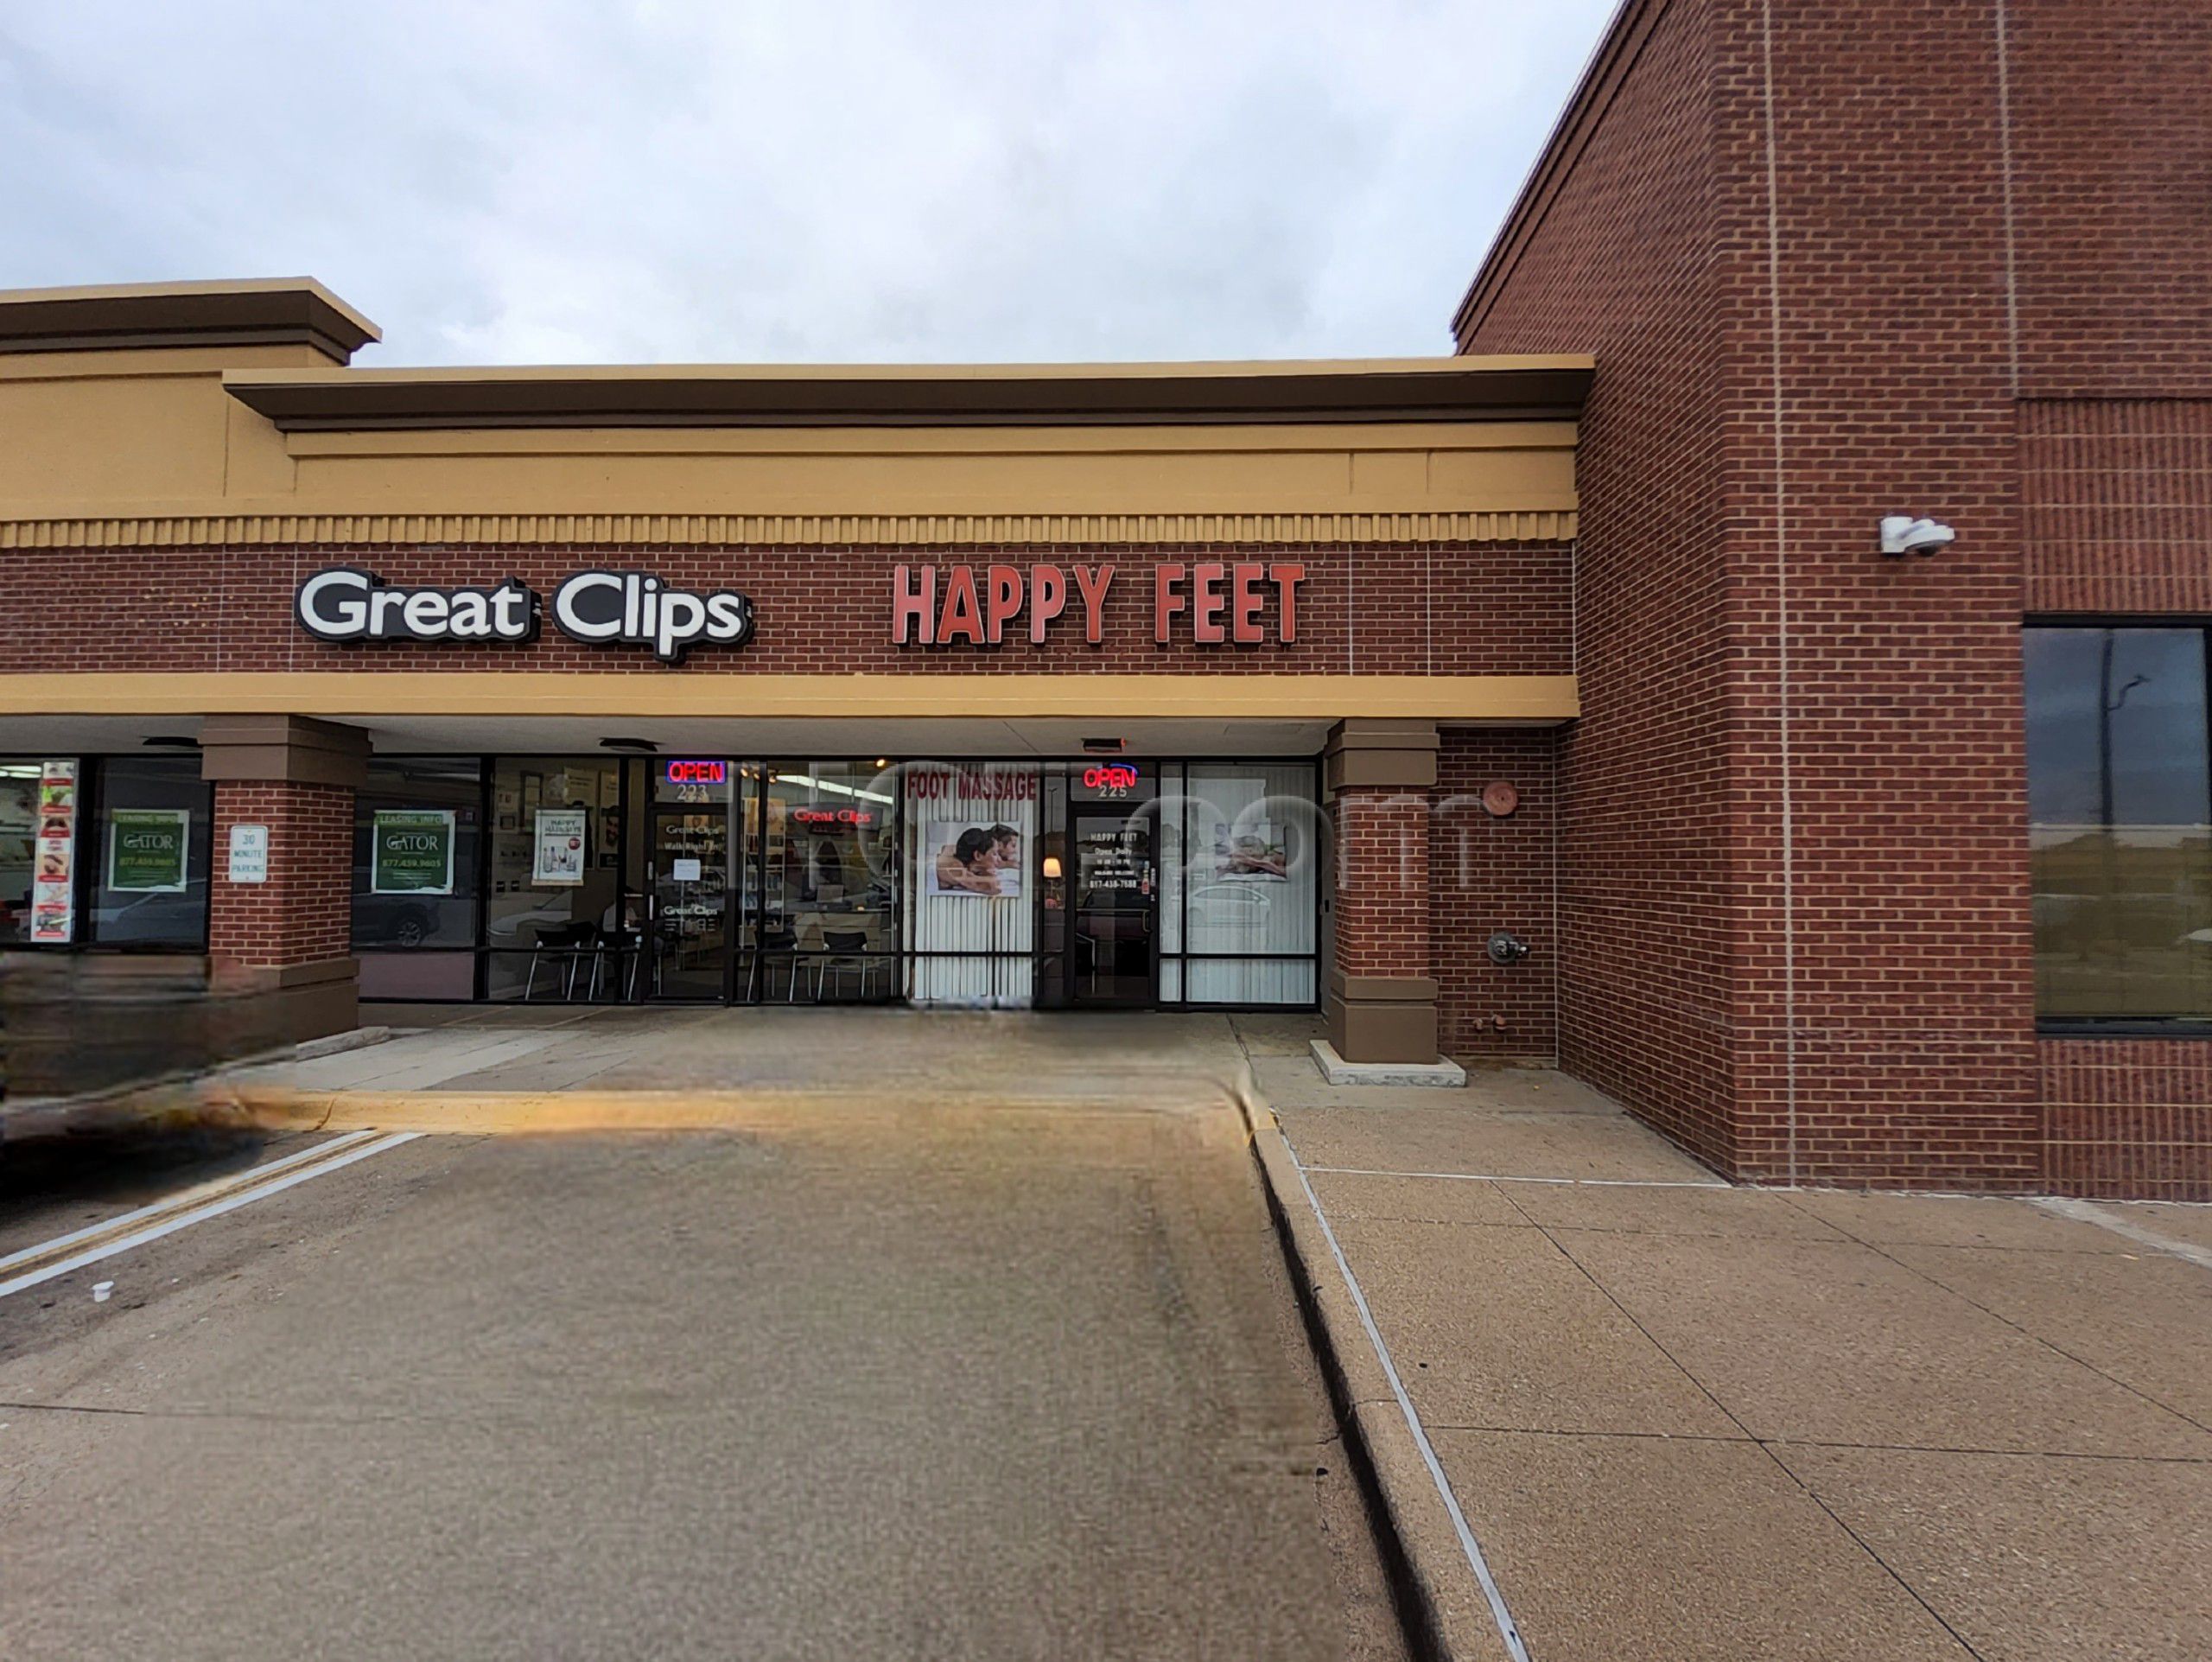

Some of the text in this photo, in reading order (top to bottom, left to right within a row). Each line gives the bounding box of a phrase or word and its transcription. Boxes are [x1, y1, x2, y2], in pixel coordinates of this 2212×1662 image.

[893, 564, 1305, 644] HAPPY FEET
[300, 571, 742, 655] Great Clips
[669, 762, 723, 782] OPEN
[1084, 767, 1136, 787] OPEN
[677, 785, 708, 801] 223
[907, 771, 1038, 800] FOOT MASSAGE
[1097, 785, 1127, 798] 225
[794, 808, 872, 824] Great Clips
[124, 834, 174, 849] GATOR
[242, 834, 256, 845] 30
[386, 835, 439, 850] GATOR
[1090, 832, 1138, 842] HAPPY FEET
[232, 864, 264, 873] PARKING
